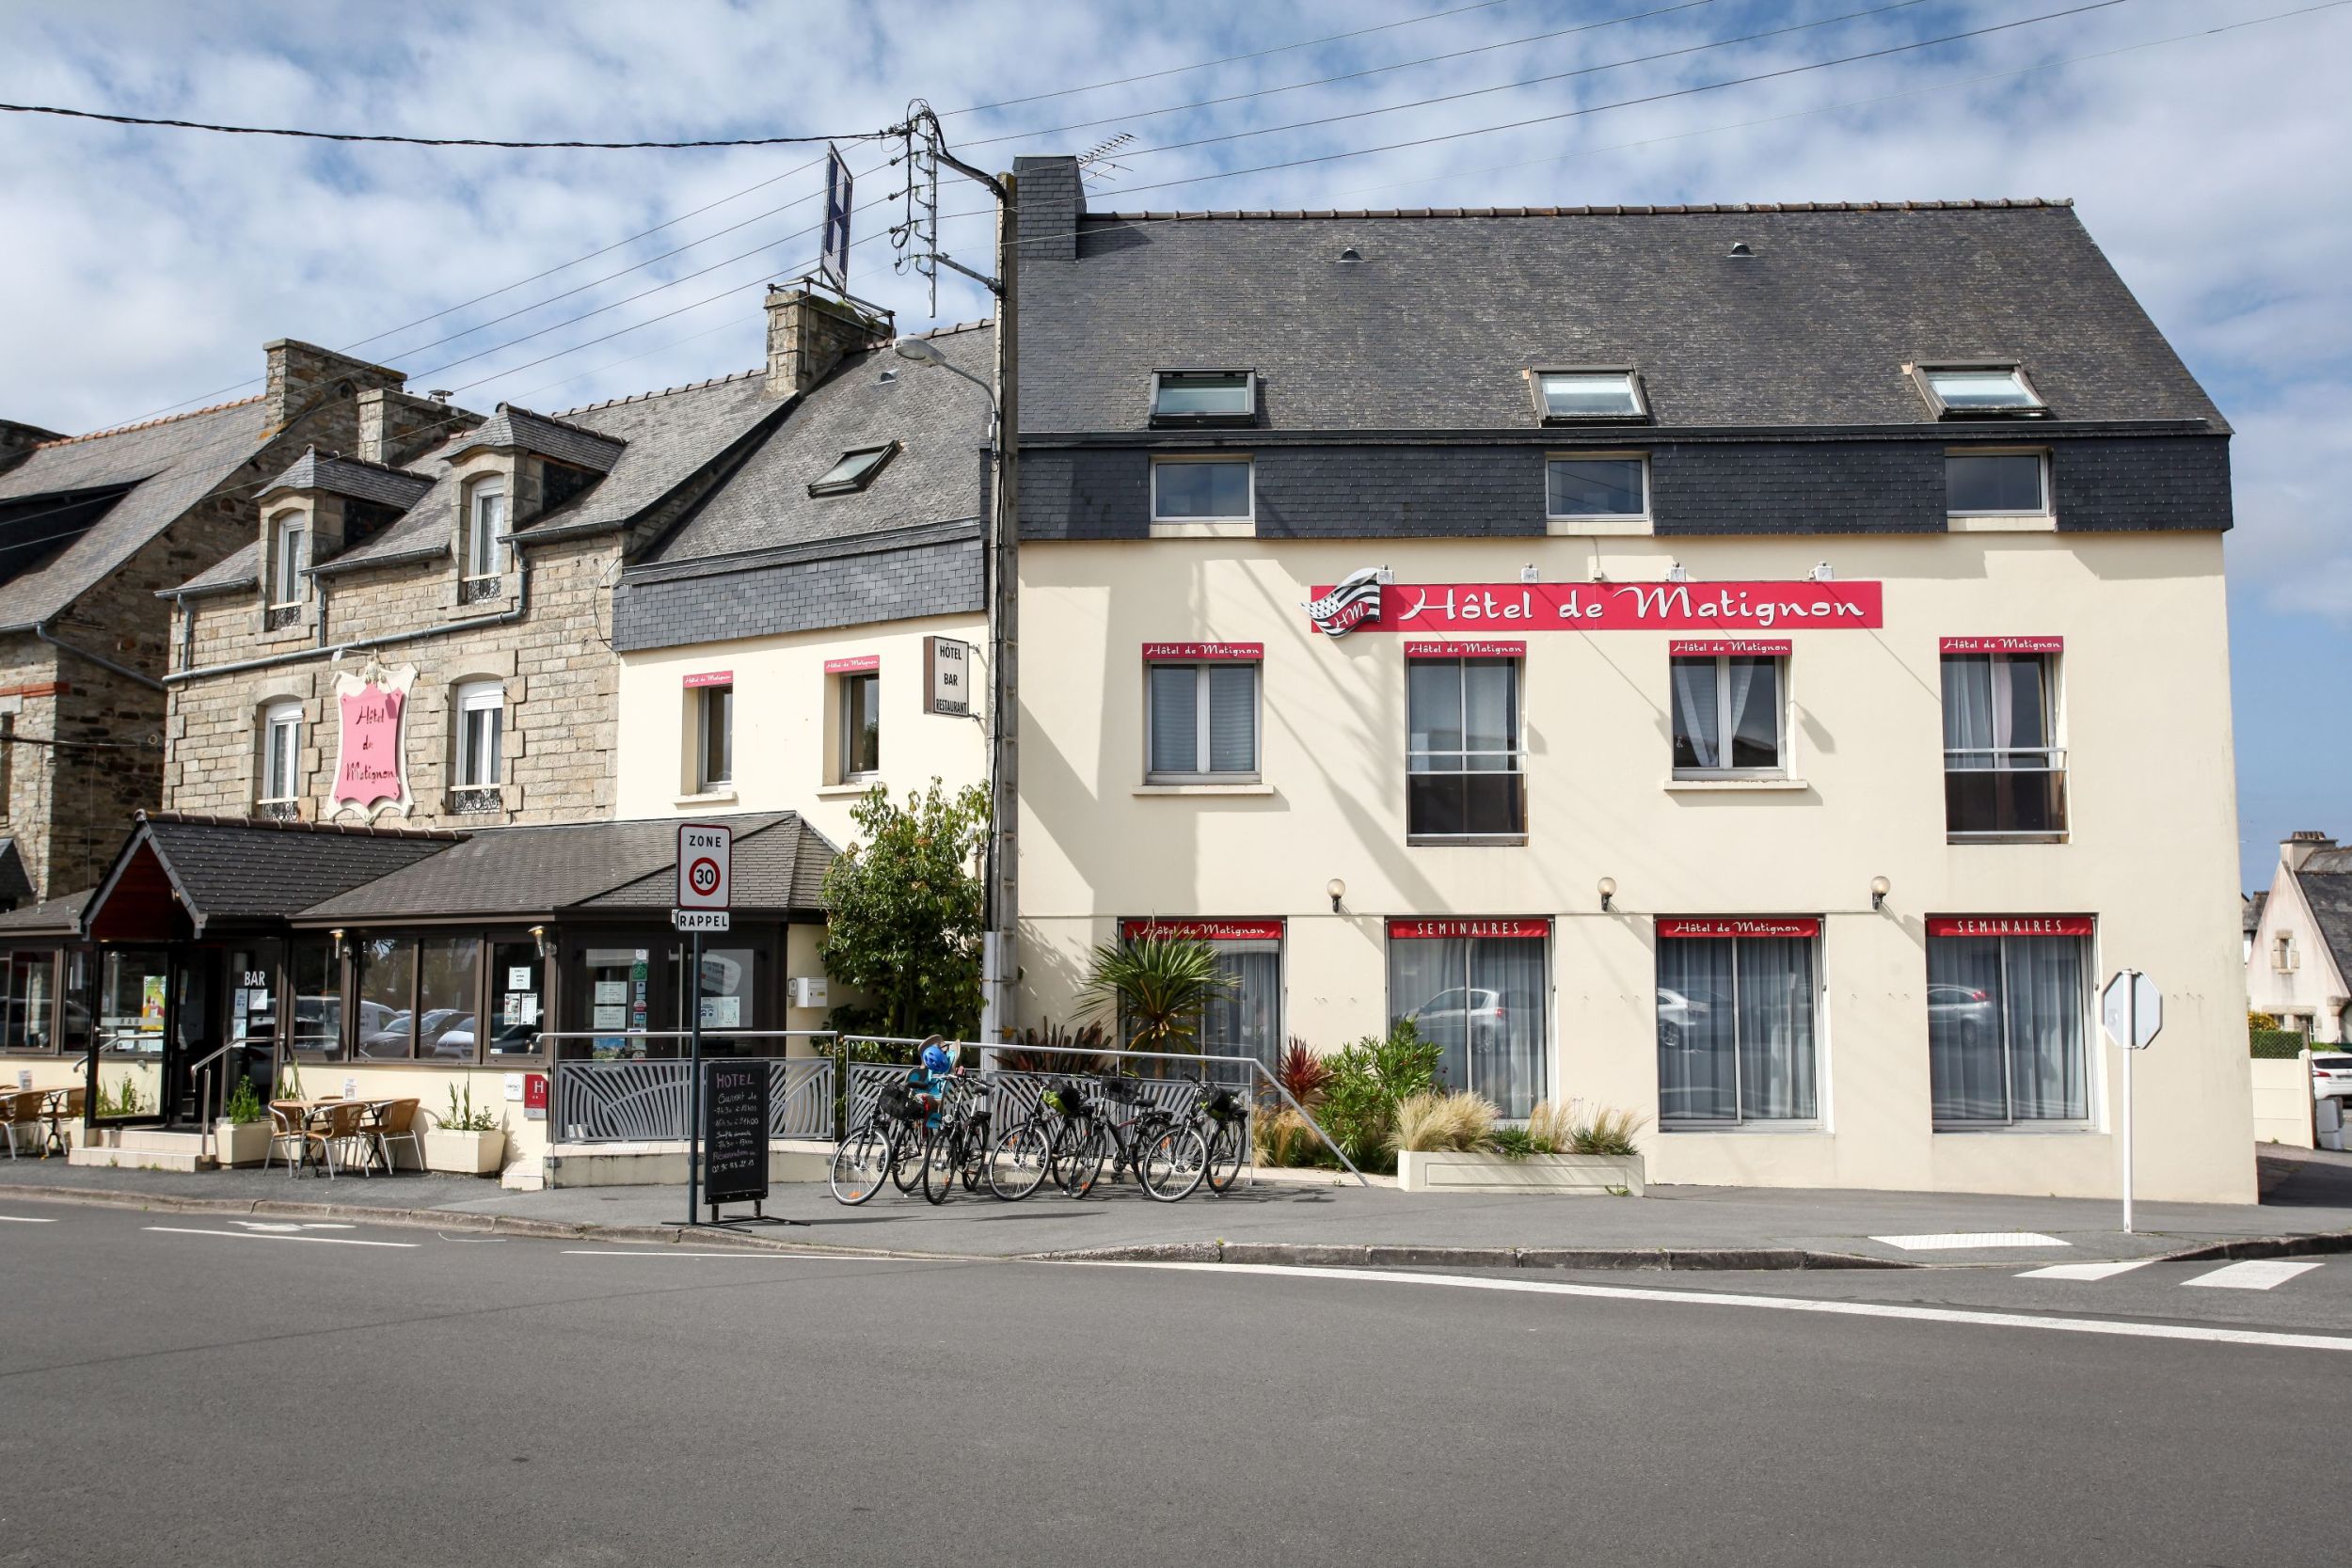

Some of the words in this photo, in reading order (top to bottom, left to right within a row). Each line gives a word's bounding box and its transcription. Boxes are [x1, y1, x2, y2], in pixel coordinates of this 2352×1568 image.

[1400, 588, 1534, 621] Hôtel
[1559, 590, 1603, 618] de
[1612, 586, 1865, 626] Matignon
[1333, 602, 1365, 629] HM
[940, 642, 961, 660] HÔTEL
[1146, 644, 1179, 656] Hôtel
[1184, 645, 1197, 656] de
[1199, 644, 1260, 657] Matignon
[1408, 642, 1441, 654] Hôtel
[1447, 643, 1459, 654] de
[1460, 642, 1522, 656] Matignon
[1673, 641, 1707, 653] Hôtel
[1712, 641, 1724, 652] de
[1725, 641, 1788, 655] Matignon
[1944, 639, 1978, 651] Hôtel
[1983, 639, 1995, 650] de
[1997, 639, 2061, 652] Matignon
[944, 673, 958, 687] BAR
[936, 698, 967, 714] RESTAURANT
[355, 705, 384, 725] Hôtel
[362, 734, 373, 750] de
[346, 760, 395, 784] Matignon
[689, 835, 722, 847] ZONE
[695, 868, 714, 885] 30
[679, 915, 727, 927] RAPPEL
[1417, 922, 1520, 935] SEMINAIRES
[1674, 921, 1710, 934] Hôtel
[1717, 922, 1730, 933] de
[1733, 920, 1801, 936] Matignon
[1958, 919, 2063, 933] SEMINAIRES
[1183, 925, 1197, 935] de
[1199, 923, 1265, 938] Matignon
[244, 971, 265, 987] BAR
[533, 1080, 545, 1094] H
[716, 1072, 755, 1089] HOTEL
